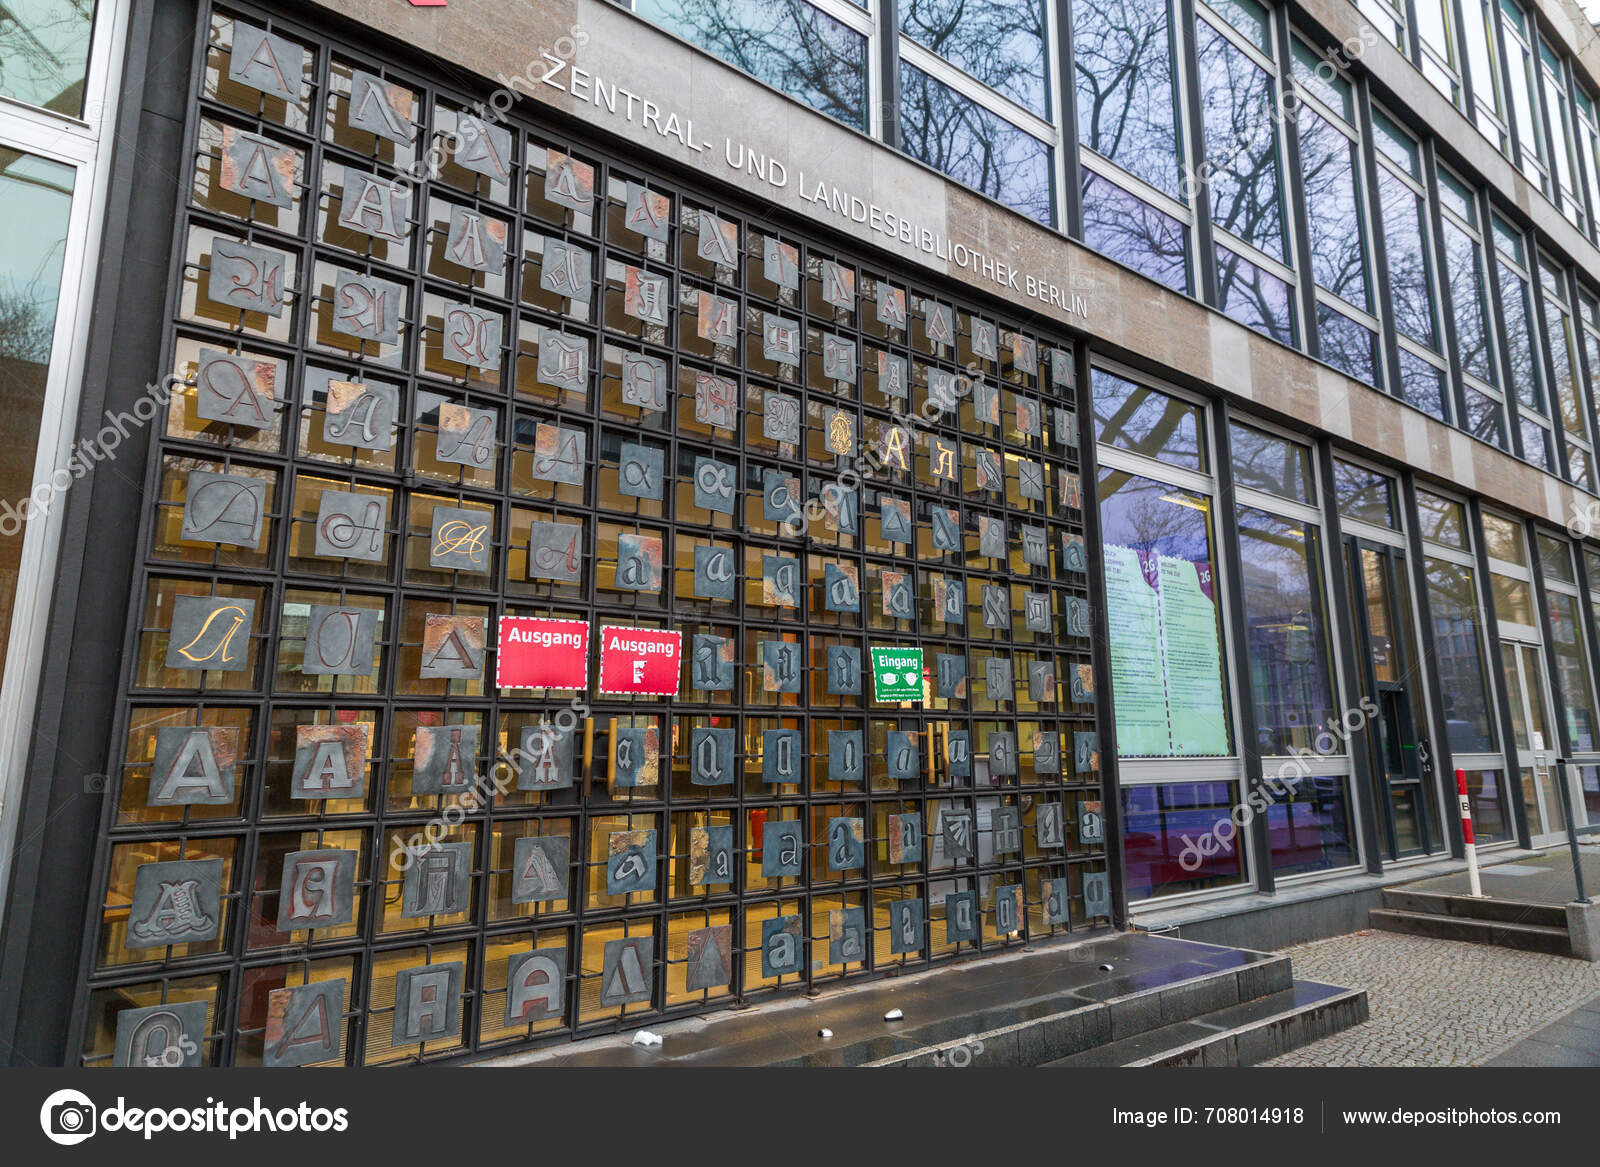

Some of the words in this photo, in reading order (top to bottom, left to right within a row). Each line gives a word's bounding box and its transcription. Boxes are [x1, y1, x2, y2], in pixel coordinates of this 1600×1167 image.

[235, 37, 293, 95] A
[541, 52, 713, 153] ZENTRAL-
[725, 137, 787, 188] UND
[799, 172, 1020, 293] LANDESBIBLIOTHEK
[1026, 275, 1088, 320] BERLIN
[1143, 560, 1156, 573] 2G
[1200, 570, 1211, 584] 2G
[508, 627, 582, 649] Ausgang
[610, 636, 674, 657] Ausgang
[424, 630, 478, 670] A
[879, 655, 918, 669] Eingang
[157, 731, 228, 799] A
[303, 742, 353, 790] A
[1462, 802, 1470, 811] B
